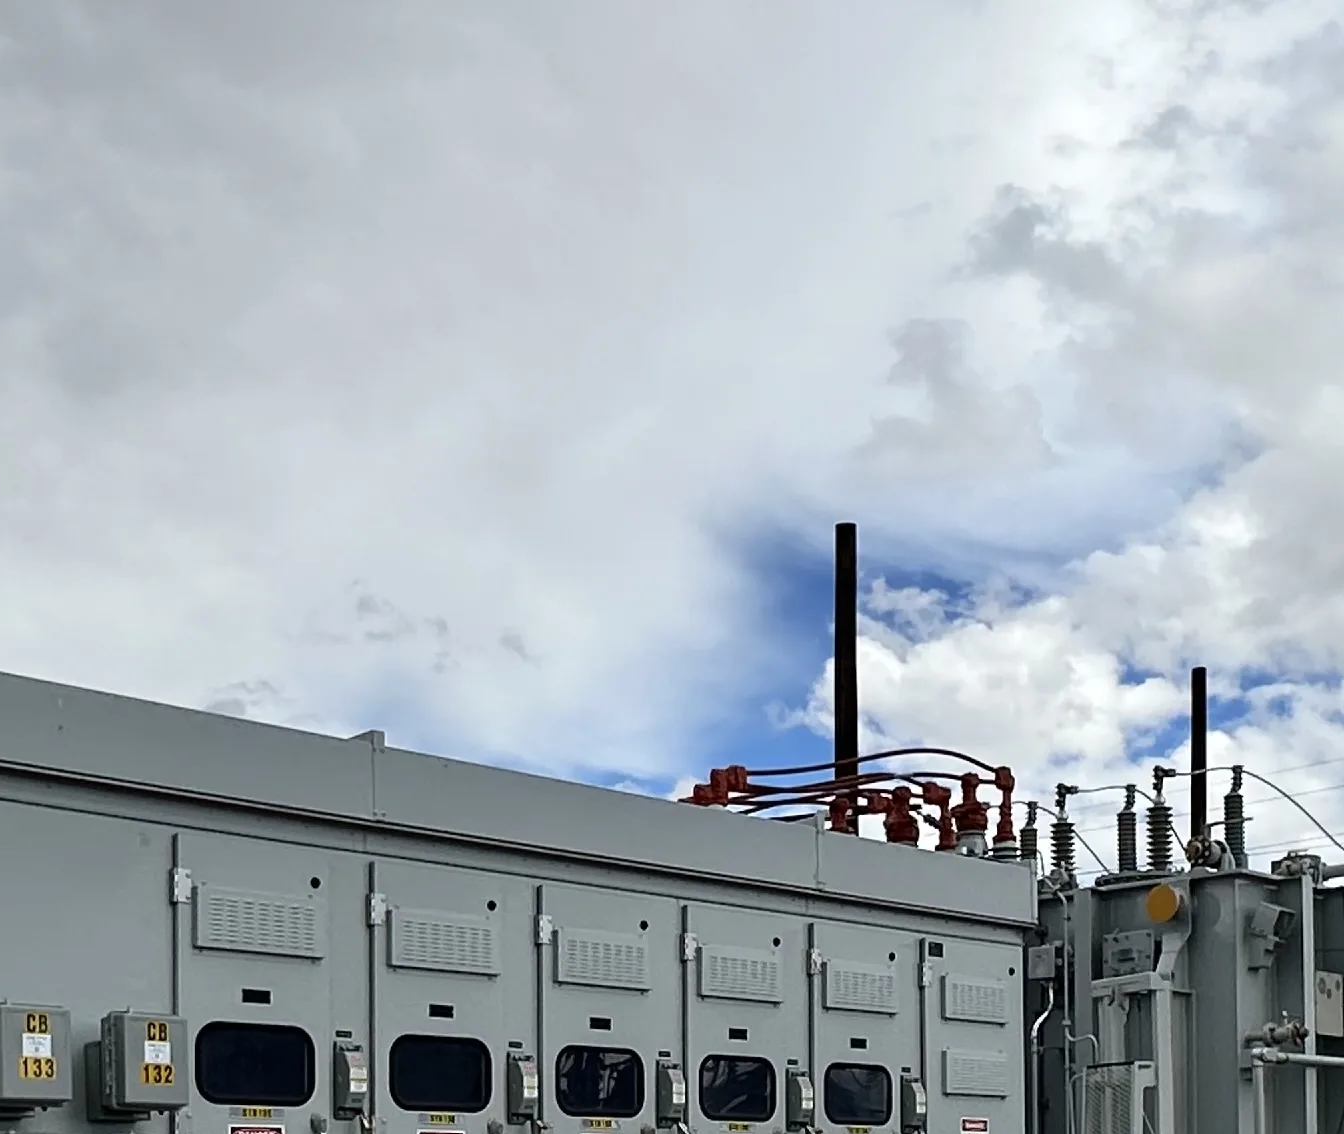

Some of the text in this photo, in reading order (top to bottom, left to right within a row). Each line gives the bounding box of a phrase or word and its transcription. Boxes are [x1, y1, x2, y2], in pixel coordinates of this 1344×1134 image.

[27, 1013, 48, 1033] CB
[148, 1022, 168, 1041] CB
[23, 1057, 54, 1078] 133
[144, 1064, 173, 1084] 132
